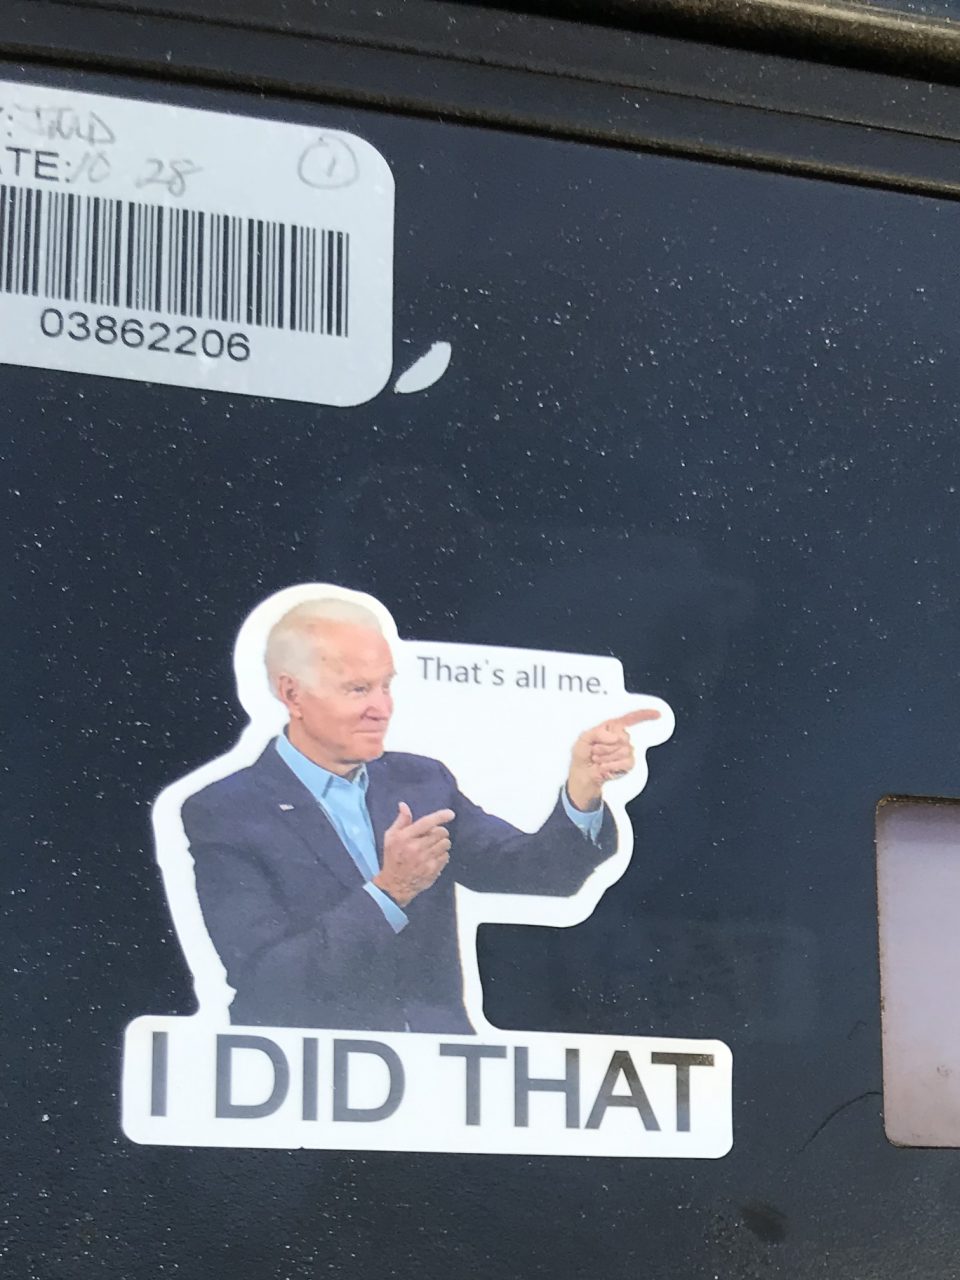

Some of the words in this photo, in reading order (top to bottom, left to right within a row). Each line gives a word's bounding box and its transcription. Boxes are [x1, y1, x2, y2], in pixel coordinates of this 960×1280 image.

[0, 145, 71, 183] TE:
[39, 307, 252, 362] 03862206
[416, 655, 505, 687] That's
[514, 663, 547, 690] all
[557, 672, 609, 696] me.
[150, 1030, 169, 1118] I
[213, 1032, 407, 1123] DID
[438, 1041, 716, 1133] THAT
